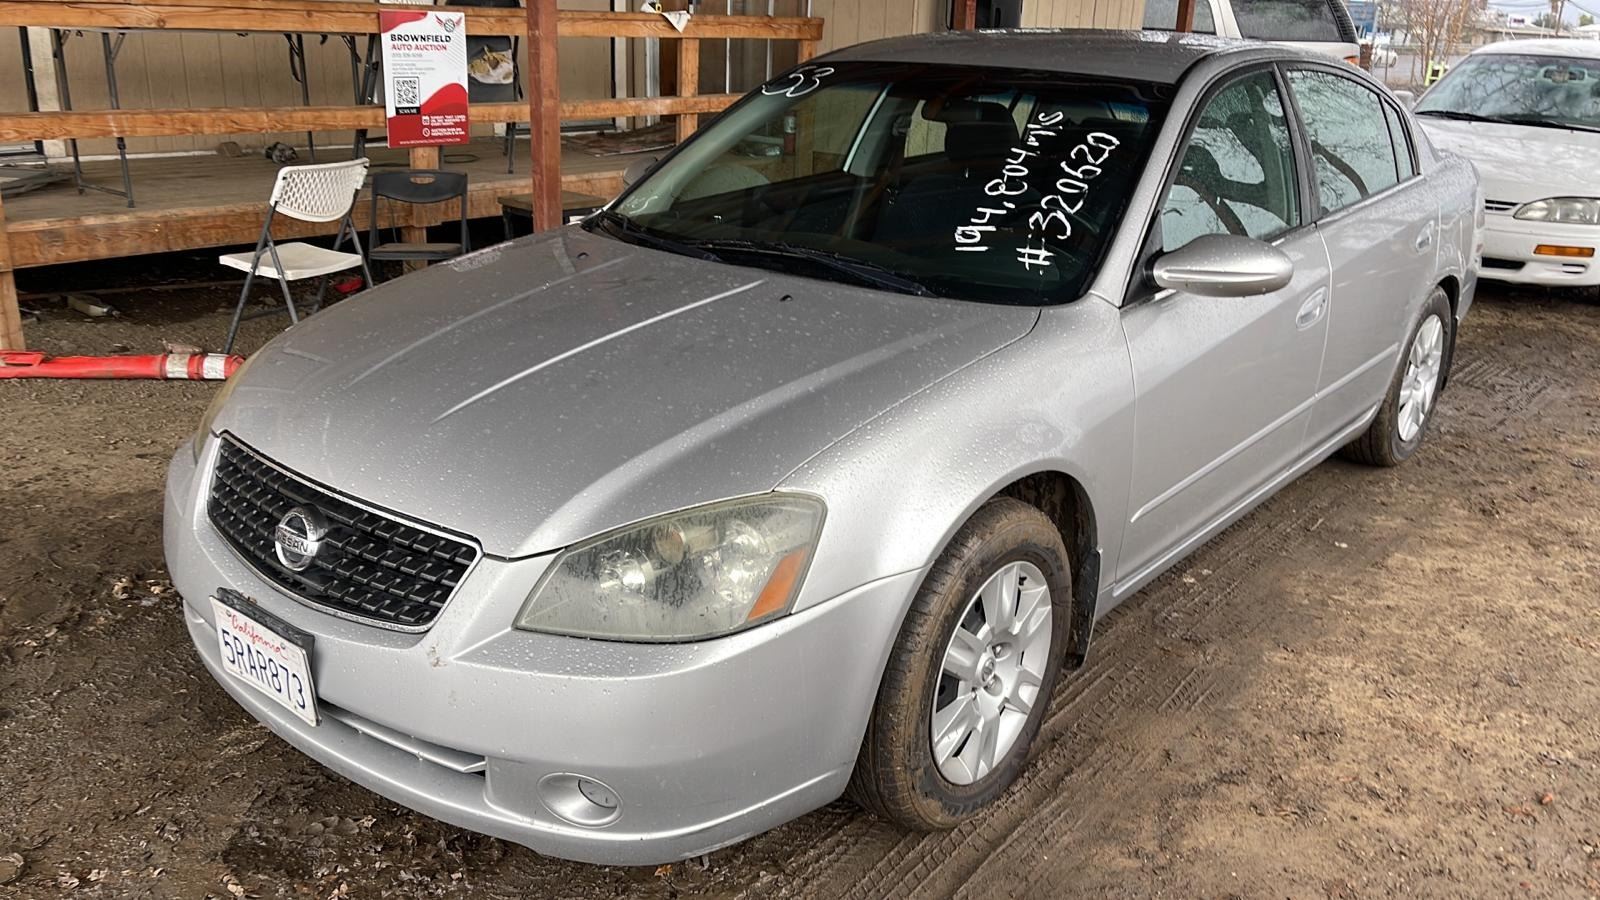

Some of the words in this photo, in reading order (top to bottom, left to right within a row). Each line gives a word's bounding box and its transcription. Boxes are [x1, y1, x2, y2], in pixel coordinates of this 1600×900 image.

[390, 33, 452, 43] BROWNFIELD
[391, 43, 413, 51] AUTO
[414, 43, 448, 51] AUCTION
[276, 528, 309, 553] NISSAN
[230, 614, 289, 660] California
[221, 628, 306, 710] 5RAR873
